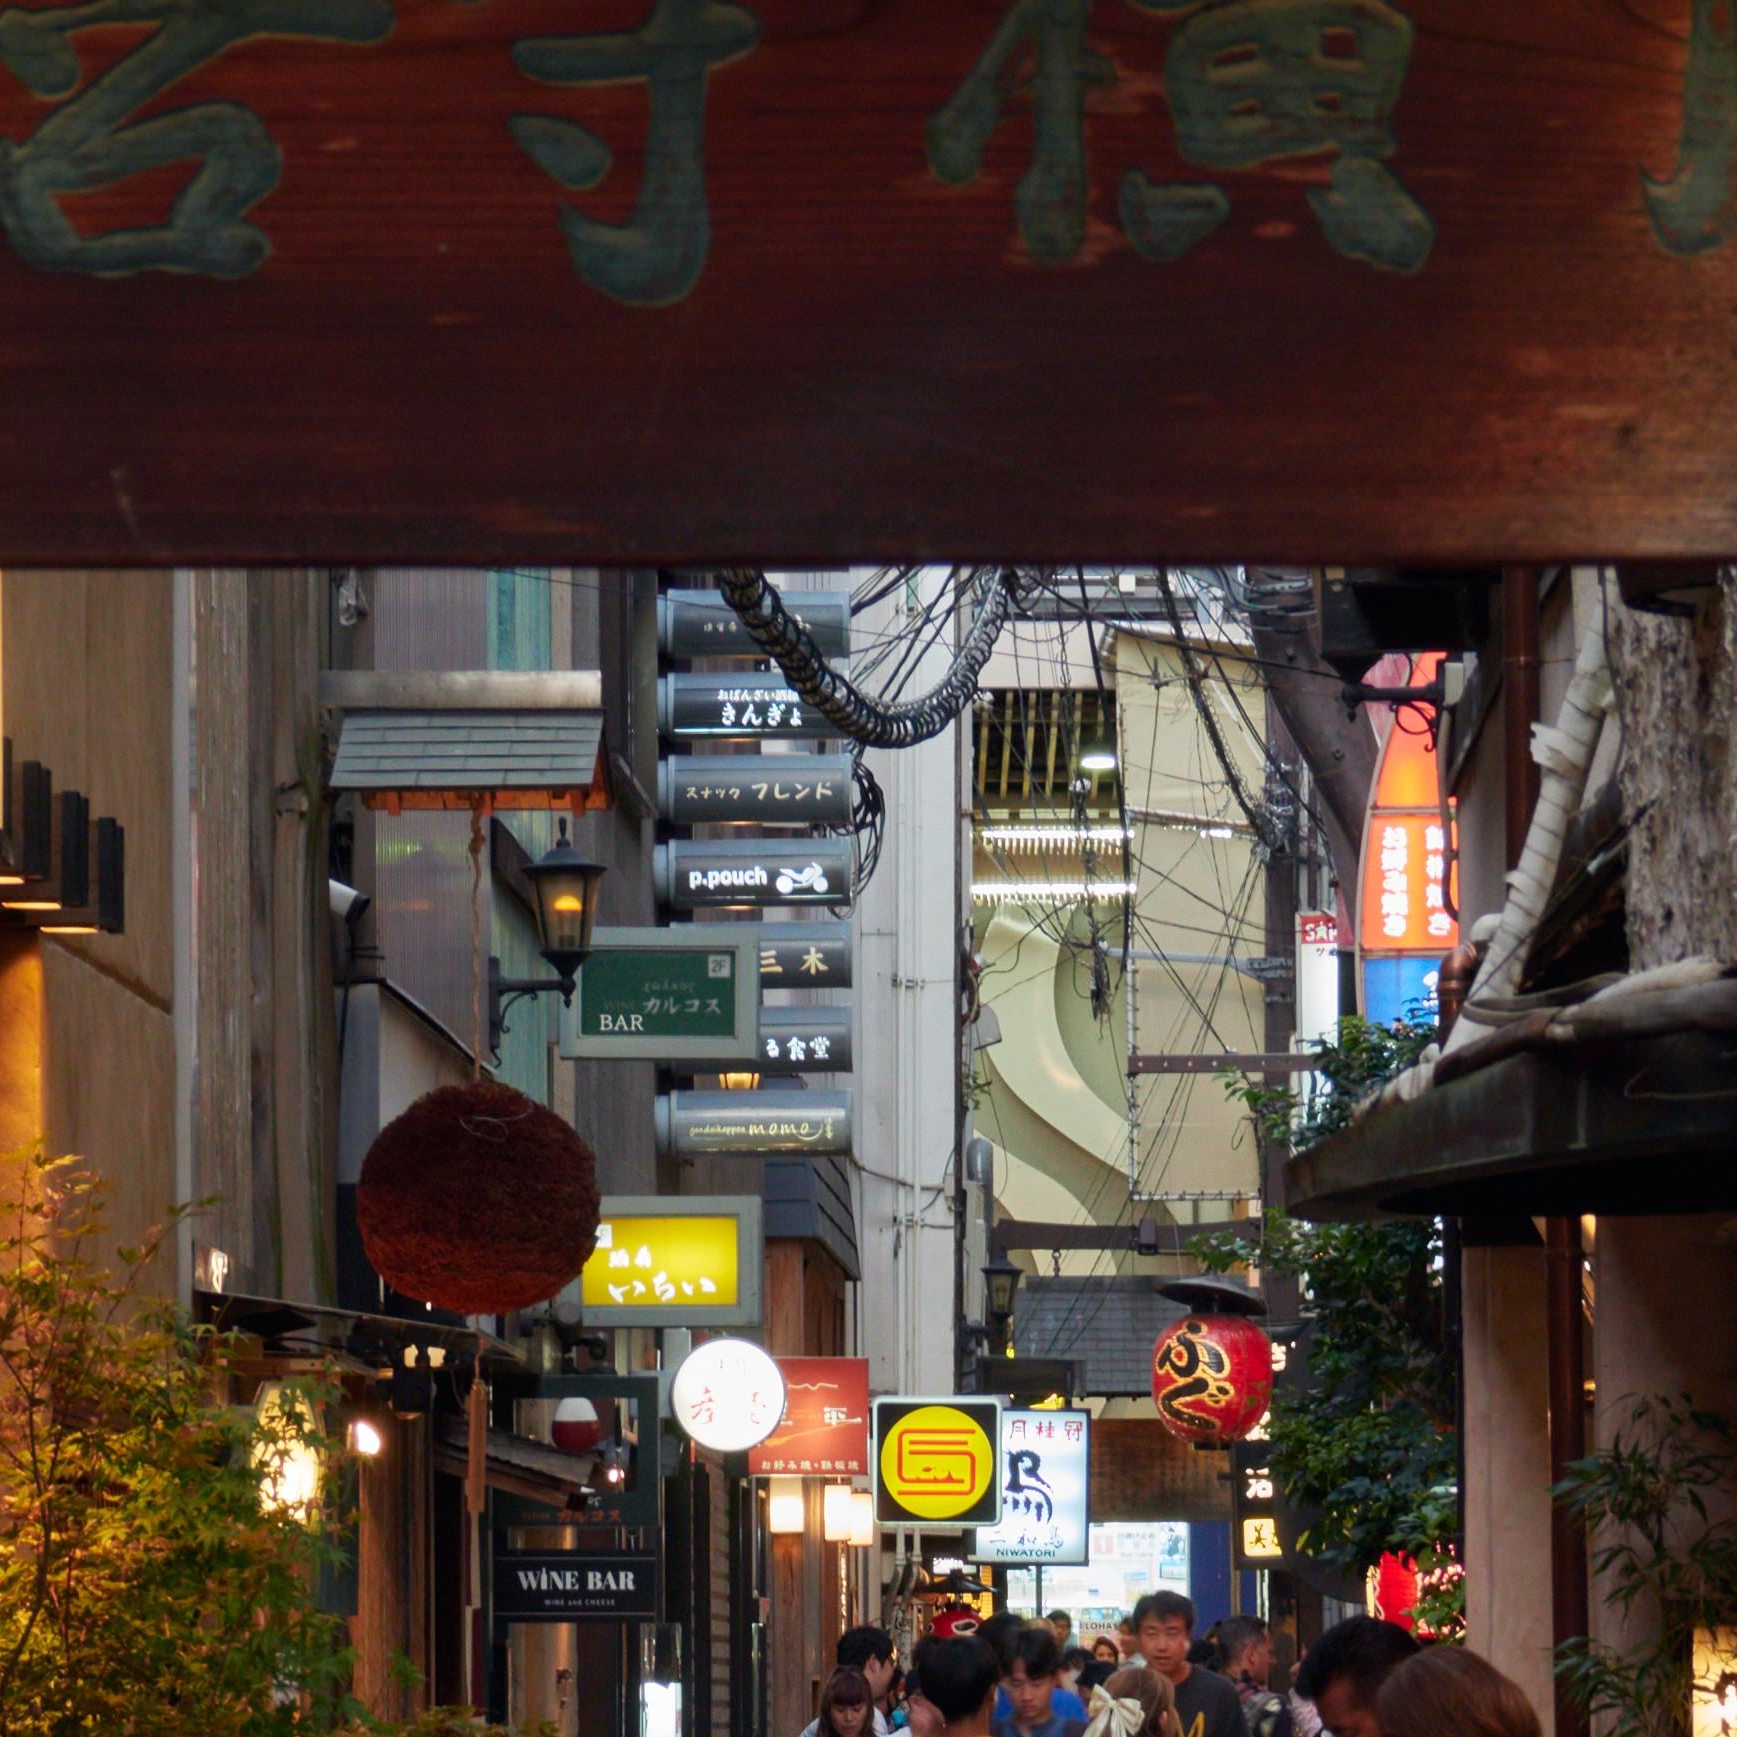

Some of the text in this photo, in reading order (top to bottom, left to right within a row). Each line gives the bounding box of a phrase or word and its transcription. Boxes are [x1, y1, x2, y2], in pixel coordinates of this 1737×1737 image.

[721, 703, 803, 727] きんぎょ
[686, 782, 833, 800] スナック フレンド
[689, 866, 768, 889] p.pouch
[711, 959, 726, 973] 2F
[643, 996, 722, 1015] カルコス
[599, 1014, 644, 1032] BAR
[748, 1121, 809, 1136] momo
[1010, 1419, 1083, 1442] 月桂冠
[995, 1548, 1056, 1558] NIWATORI
[516, 1566, 636, 1591] WINE BAR
[544, 1598, 565, 1607] WINE
[585, 1598, 616, 1607] CHEESE
